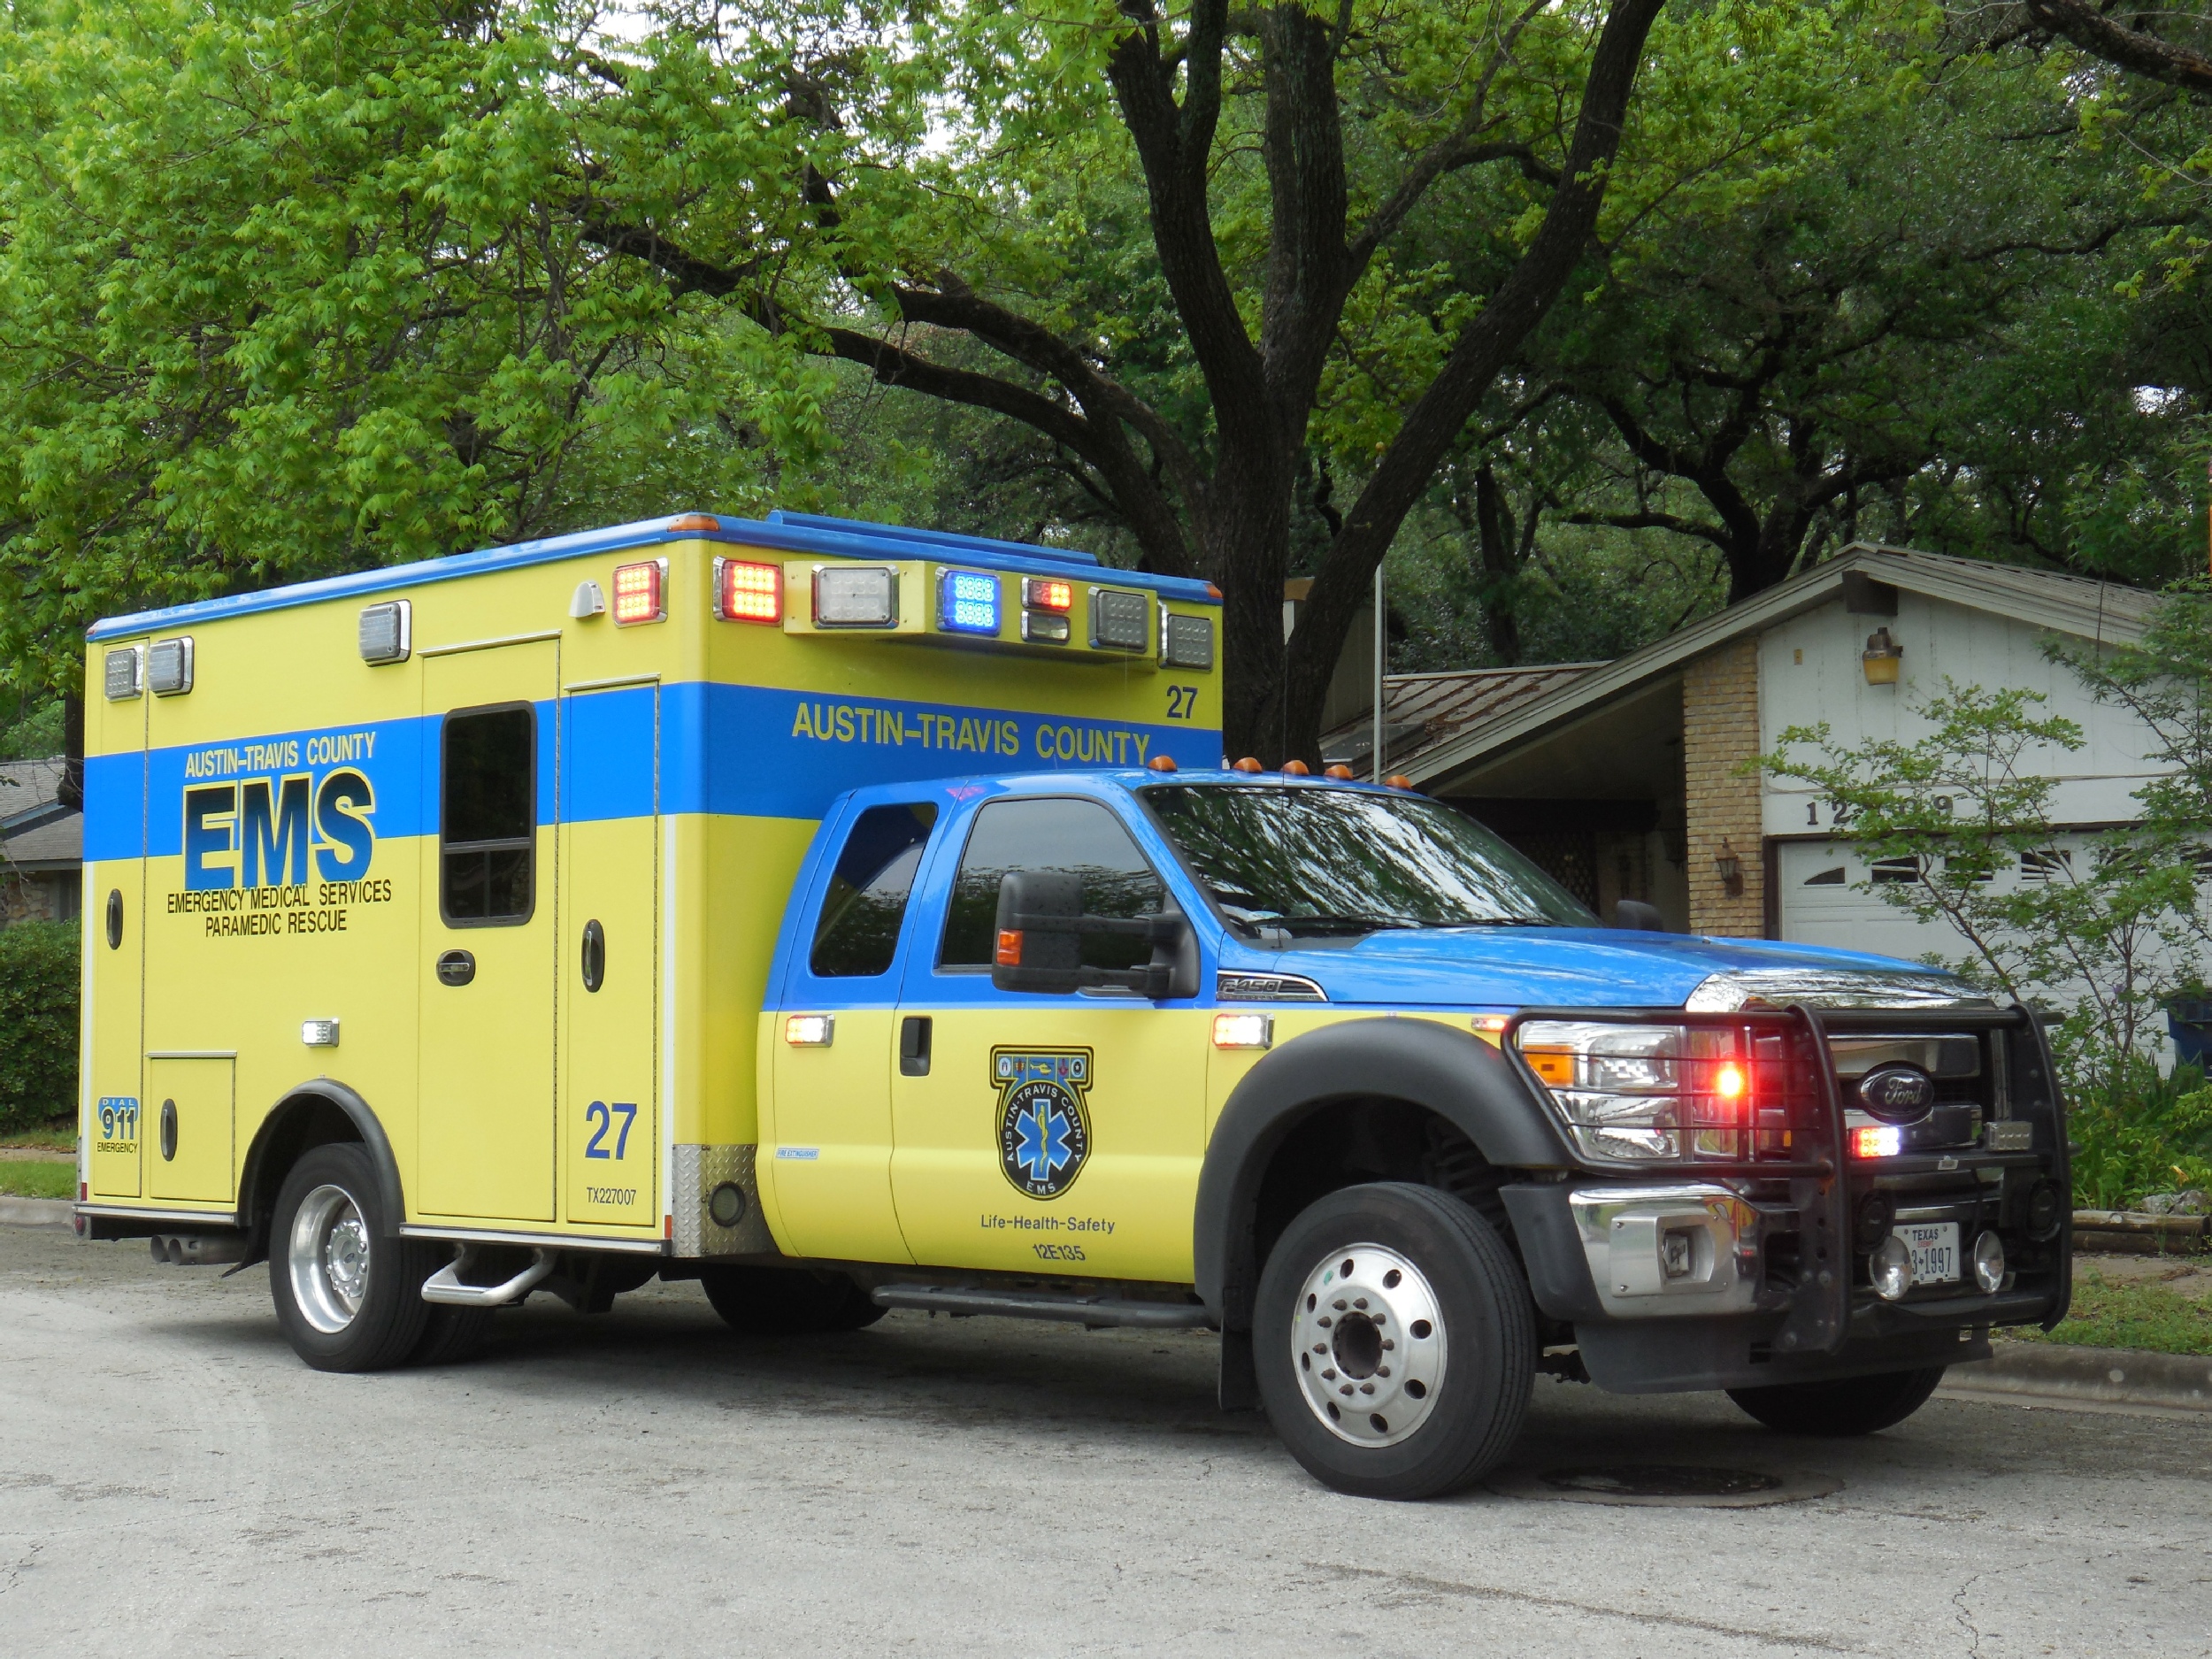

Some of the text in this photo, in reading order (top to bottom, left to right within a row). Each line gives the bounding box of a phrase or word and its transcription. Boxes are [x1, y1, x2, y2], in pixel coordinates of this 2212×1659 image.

[1166, 685, 1199, 719] 27
[792, 702, 1150, 766] AUSTIN-TRAVIS COUNTY
[185, 732, 376, 778] AUSTIN-TRAVIS COUNTY
[183, 766, 376, 891] EMS
[167, 879, 392, 913] EMERGENCY MEDICAL SERVICES
[205, 910, 348, 937] PARAMEDIC RESCUE
[1885, 1078, 1923, 1105] Ford
[101, 1108, 135, 1141] 911
[585, 1101, 637, 1160] 27
[1005, 1084, 1083, 1163] AUSTIN-TRAVIS COUNTY
[97, 1141, 138, 1154] EMERGENCY
[587, 1187, 637, 1206] TX227007
[1026, 1180, 1056, 1194] EMS
[981, 1215, 1115, 1234] Life-Health-Safety
[1912, 1228, 1939, 1240] TEXAS
[1033, 1243, 1086, 1261] 12E135
